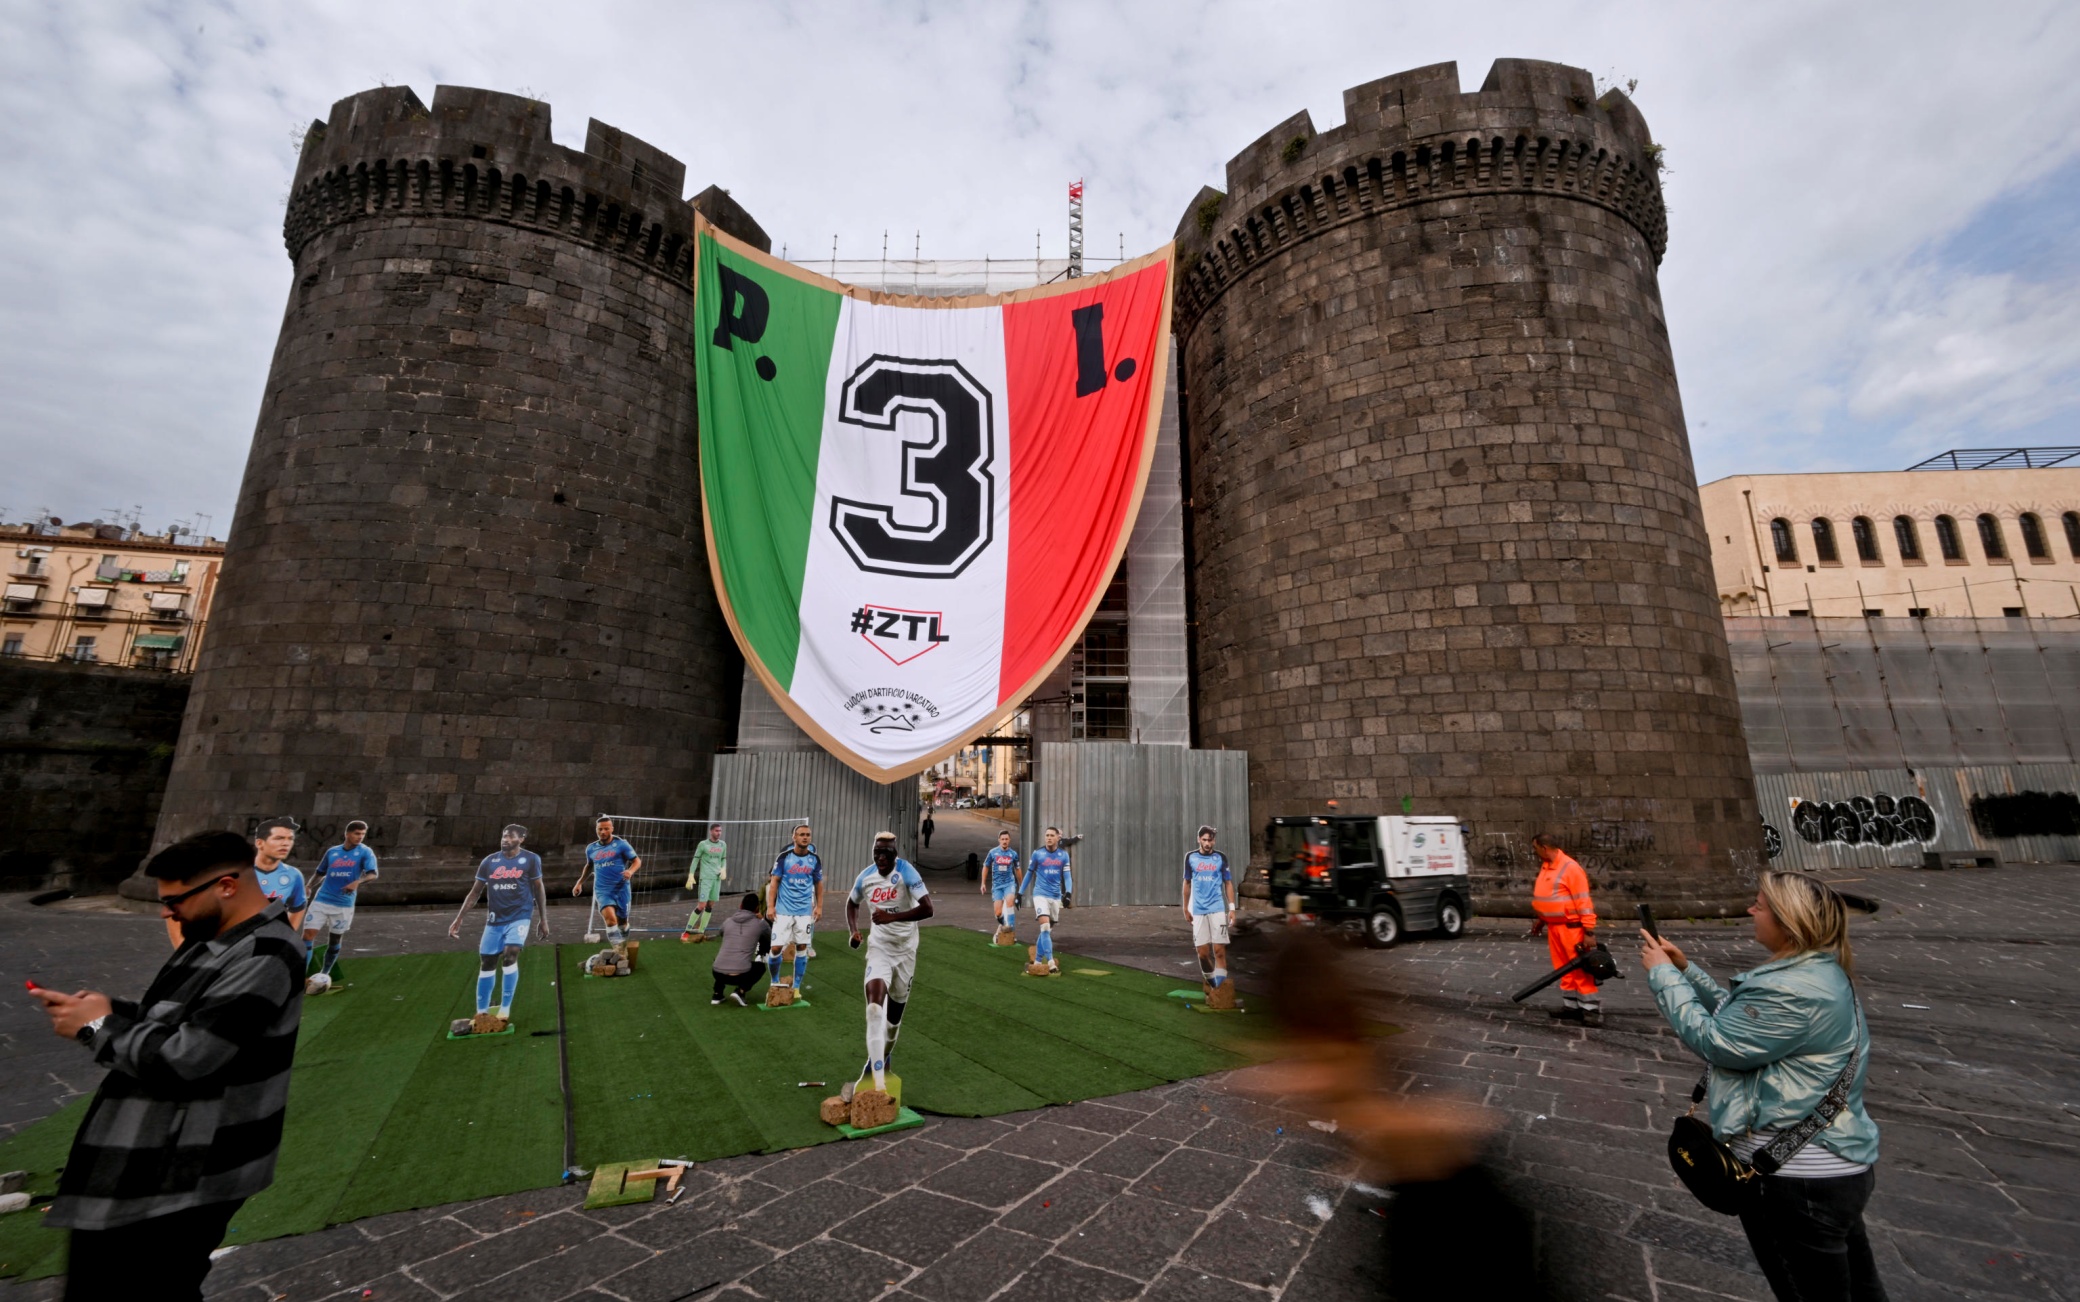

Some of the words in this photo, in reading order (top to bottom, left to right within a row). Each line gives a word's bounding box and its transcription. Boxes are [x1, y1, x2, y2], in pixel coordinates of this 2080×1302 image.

[829, 353, 995, 580] 3
[851, 608, 950, 642] #ZTL
[843, 690, 867, 712] FUOCHI
[905, 690, 940, 718] VARCATURO
[594, 849, 617, 860] Lete
[489, 865, 524, 879] Lete
[786, 863, 813, 874] Lete
[1195, 862, 1217, 872] Lete
[870, 888, 898, 903] Lete
